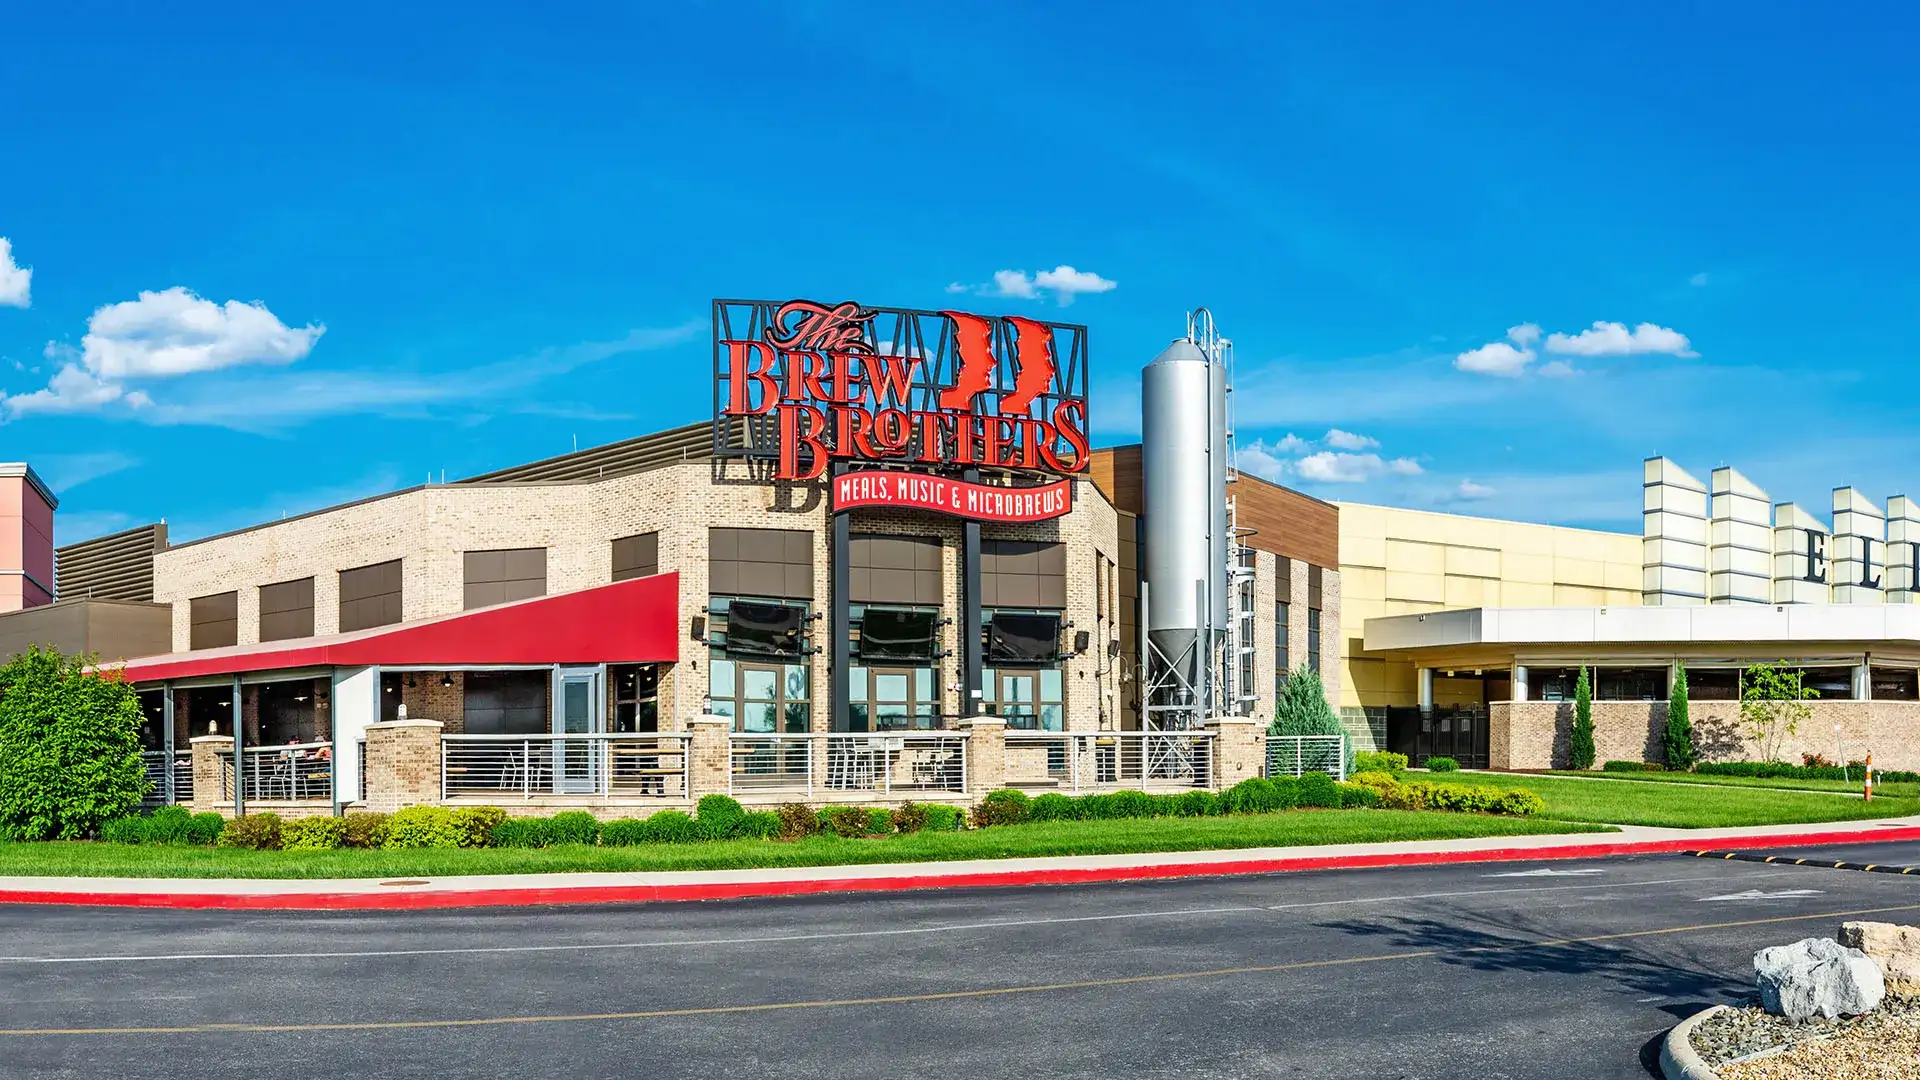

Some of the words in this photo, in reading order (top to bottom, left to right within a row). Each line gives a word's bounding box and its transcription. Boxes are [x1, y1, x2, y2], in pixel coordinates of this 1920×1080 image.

[766, 300, 879, 354] The
[719, 340, 923, 415] BREW
[775, 400, 1091, 480] BROTHERS
[840, 477, 893, 502] MEALS,
[897, 477, 945, 506] MUSIC
[951, 486, 961, 509] &
[967, 488, 1064, 517] MICROBREWS
